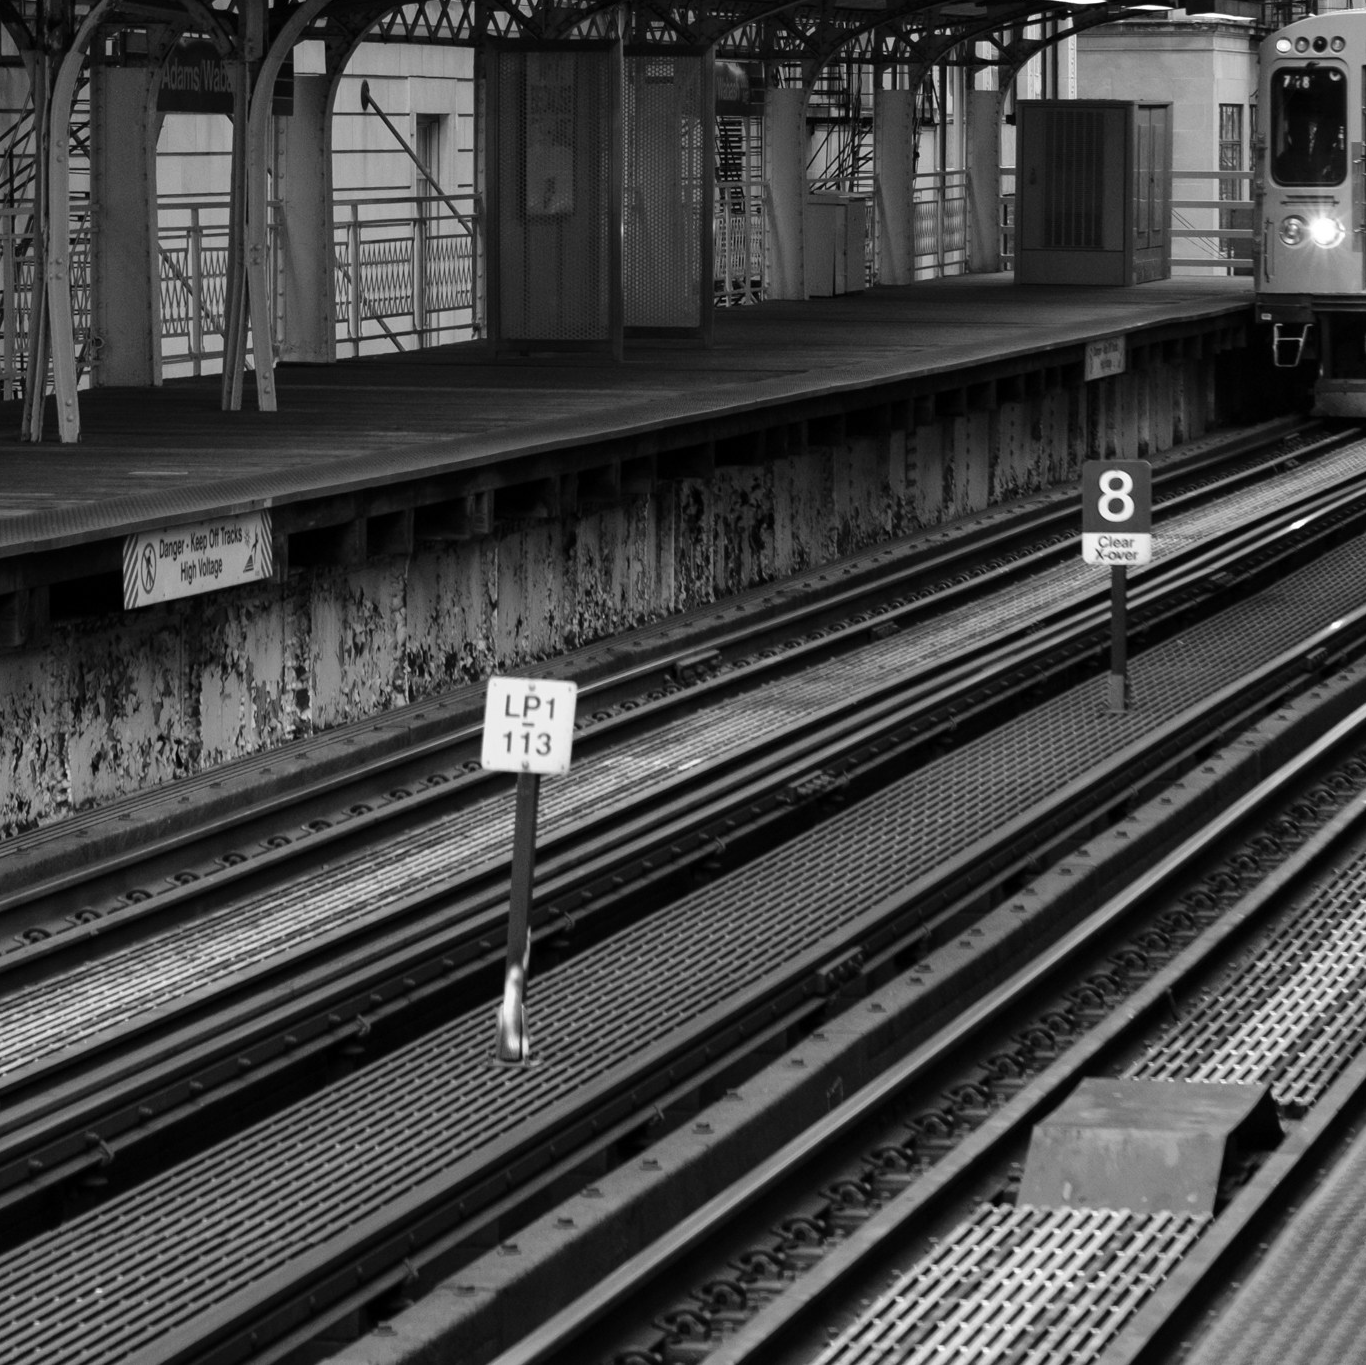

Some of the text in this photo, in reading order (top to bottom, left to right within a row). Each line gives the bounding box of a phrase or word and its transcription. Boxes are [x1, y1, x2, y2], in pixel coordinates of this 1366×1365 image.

[1098, 469, 1134, 523] 8
[159, 539, 185, 561] Danger
[190, 532, 207, 555] Keep
[209, 527, 220, 547] Off
[220, 525, 242, 546] Tracks
[1095, 548, 1138, 561] X-over
[1098, 536, 1135, 549] Clear
[180, 557, 223, 584] High Voltage
[505, 694, 555, 719] LP1
[503, 731, 551, 756] 113
